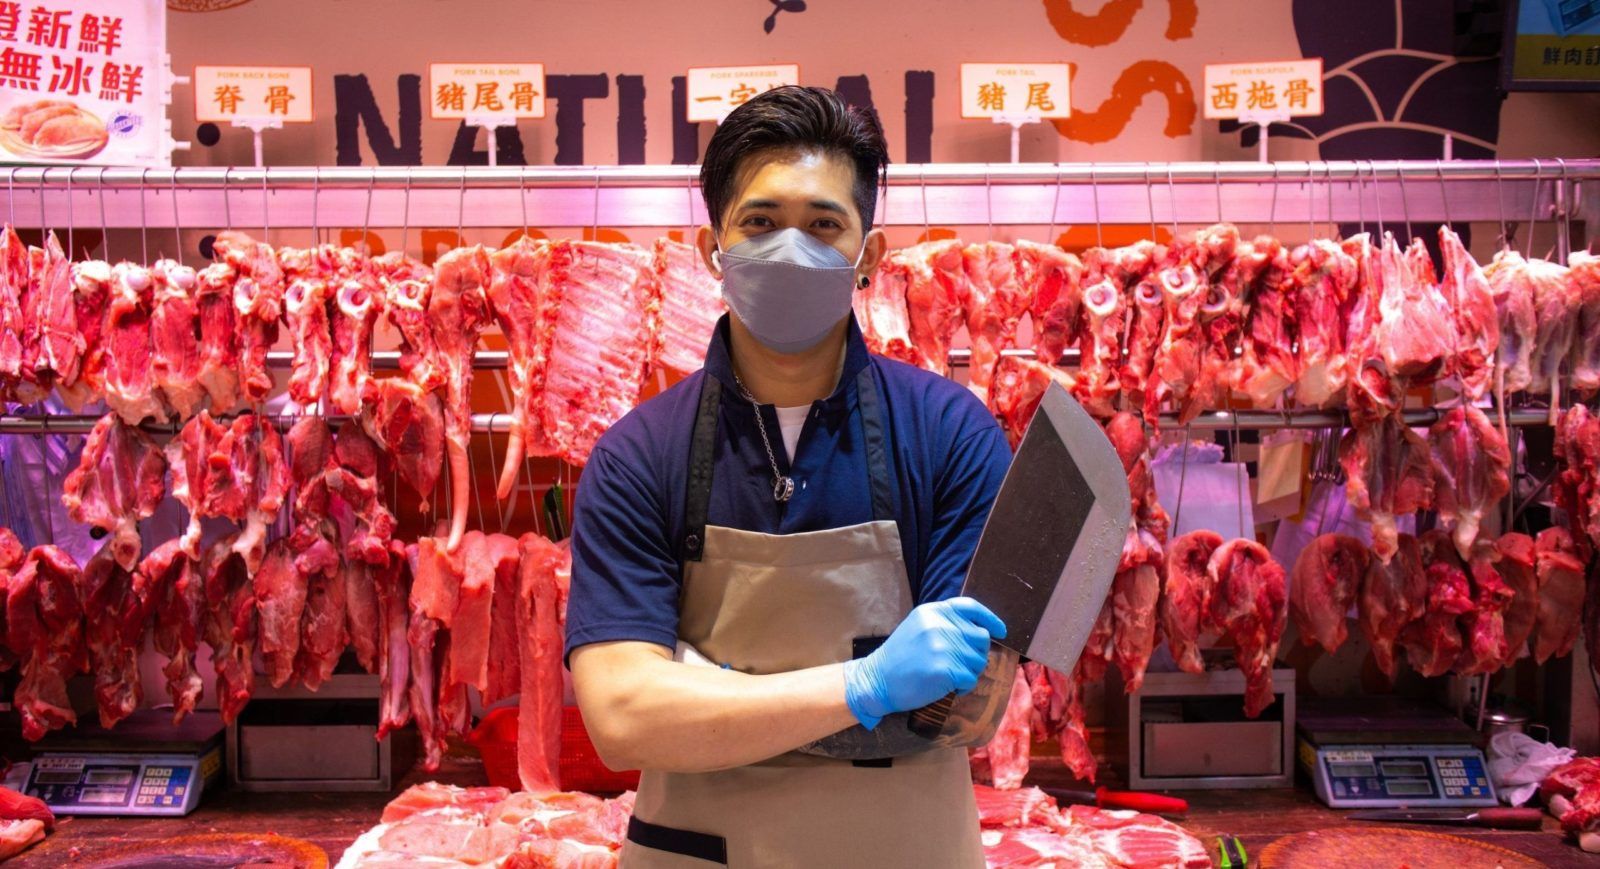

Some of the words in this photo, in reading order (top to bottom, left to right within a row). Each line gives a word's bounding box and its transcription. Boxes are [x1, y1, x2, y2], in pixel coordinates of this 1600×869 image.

[435, 81, 540, 112] 豬尾骨
[977, 81, 1055, 111] 豬尾
[1211, 79, 1314, 109] 西施骨
